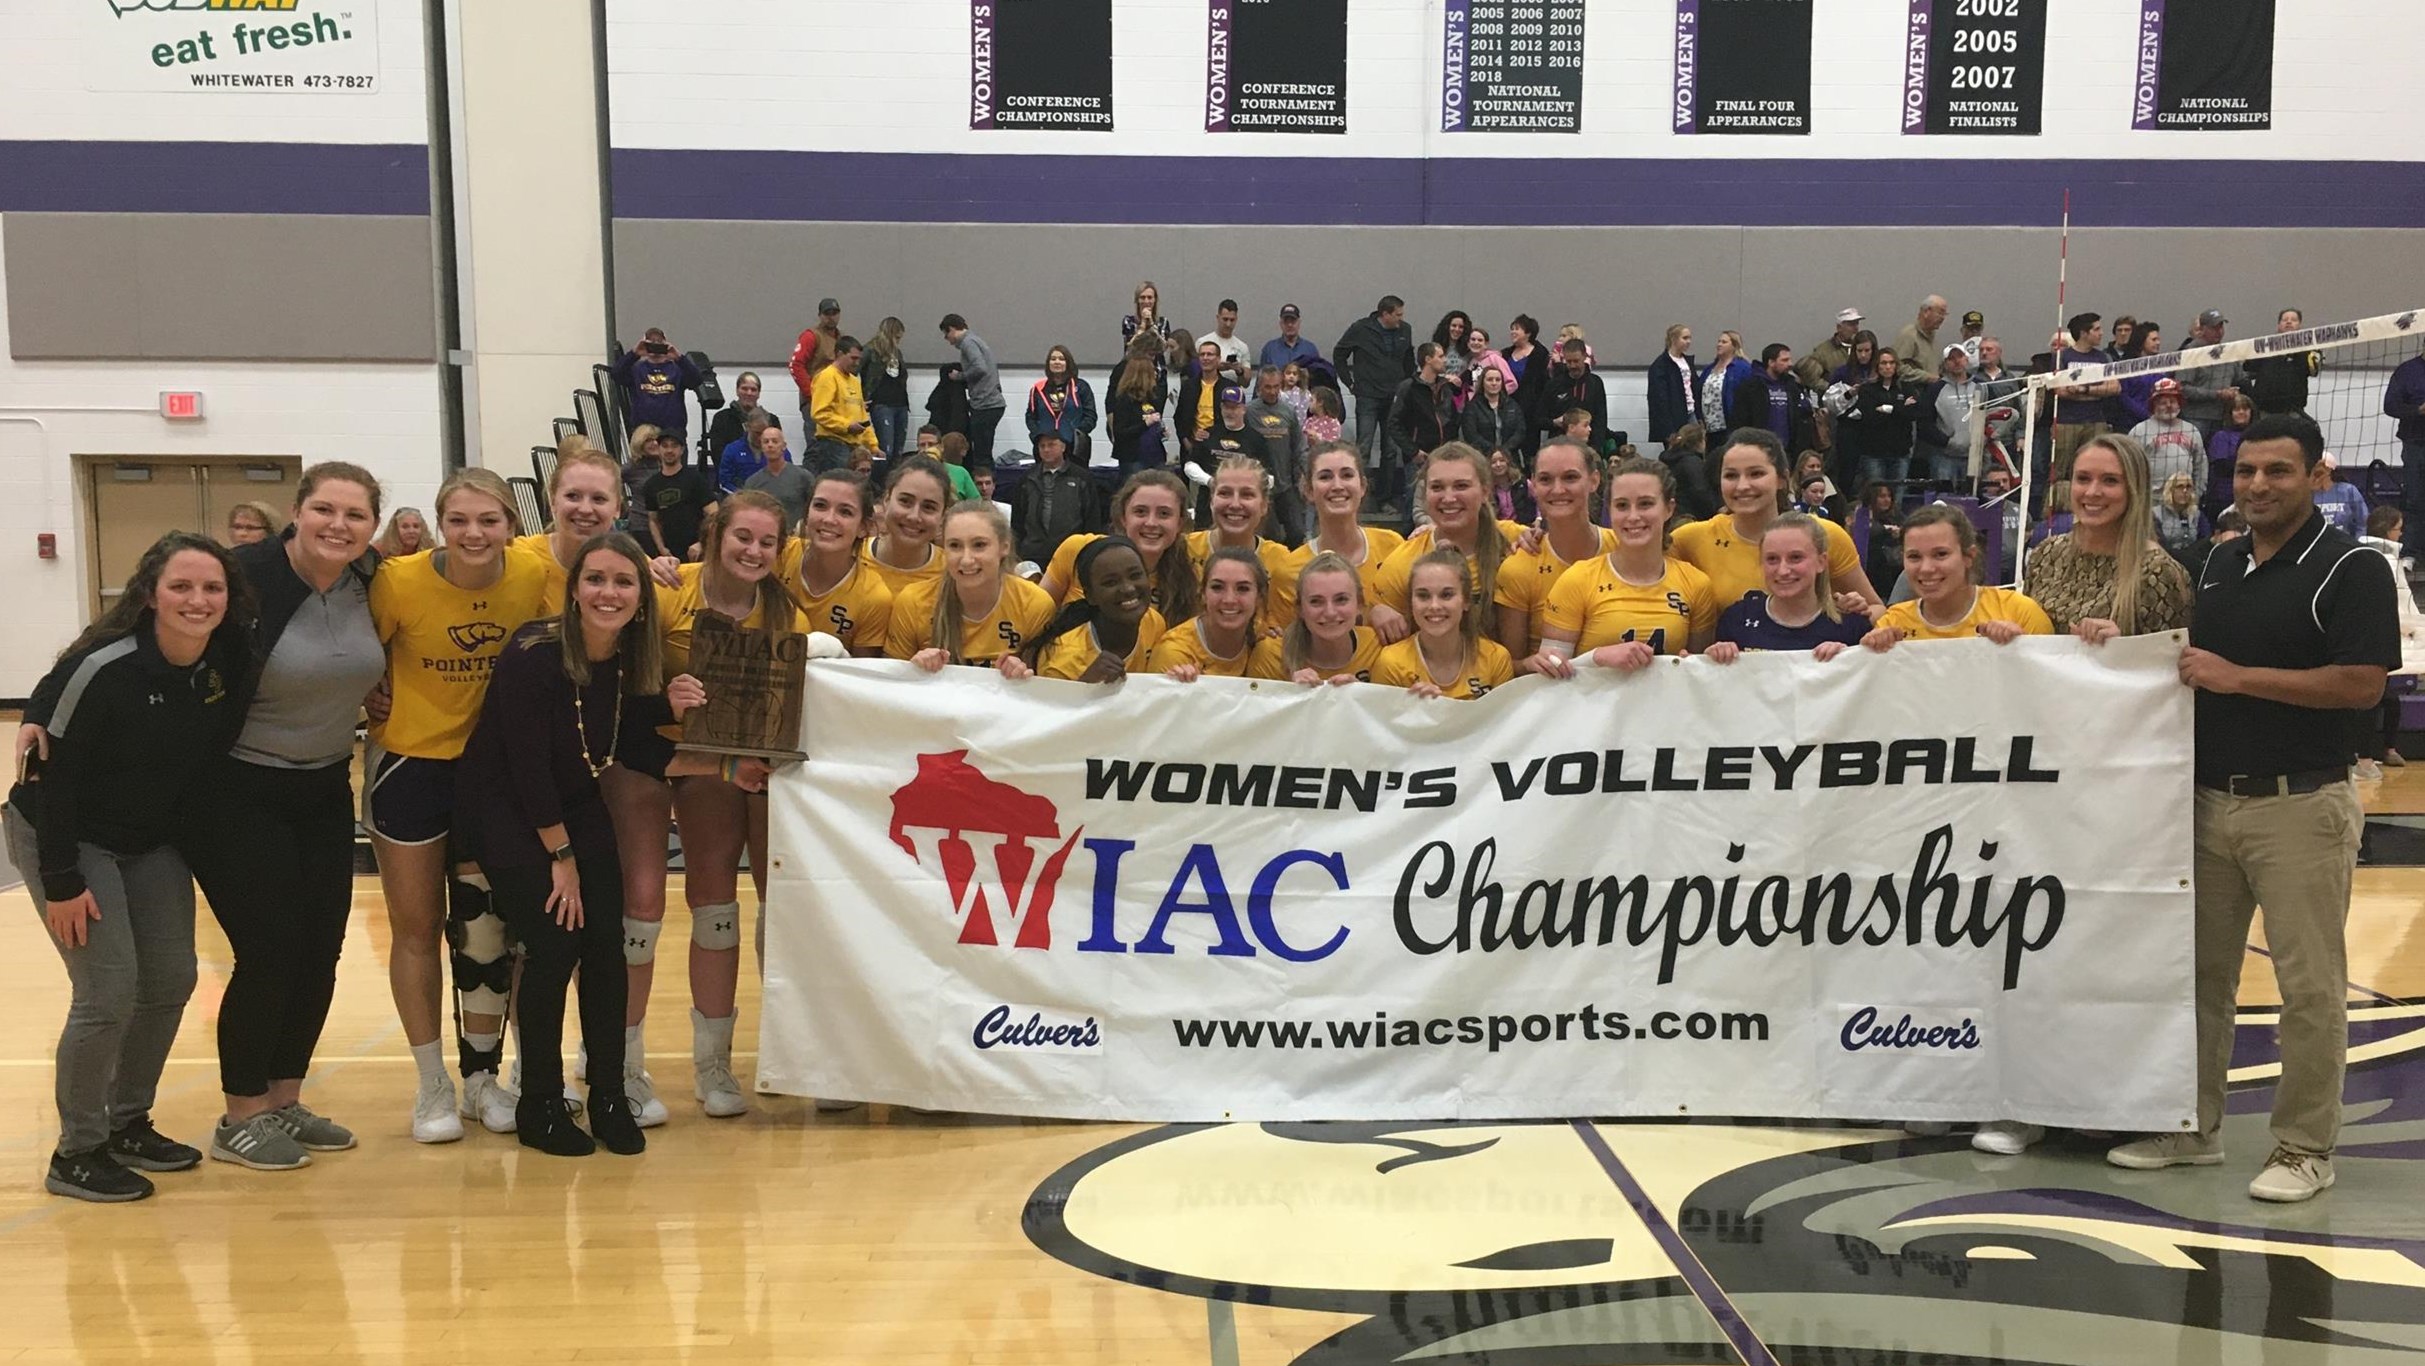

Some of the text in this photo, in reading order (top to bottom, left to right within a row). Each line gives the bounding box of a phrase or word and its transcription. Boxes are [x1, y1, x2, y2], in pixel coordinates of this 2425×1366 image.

[1471, 7, 1582, 20] 2005 2006 2007
[1471, 23, 1582, 36] 2008 2009 2010
[151, 30, 217, 68] eat
[232, 12, 352, 55] fresh.
[1470, 39, 1582, 52] 2011 2012 2013
[1953, 30, 2018, 53] 2005
[974, 4, 991, 123] WOMEN'S
[1209, 8, 1228, 125] WOMEN'S
[1470, 55, 1581, 67] 2014 2015 2016
[2136, 9, 2160, 123] WOMEN'S
[1445, 10, 1464, 129] WOMEN'S
[1470, 71, 1502, 82] 2018
[1676, 12, 1694, 127] WOMEN'S
[1905, 12, 1928, 128] WOMEN'S
[190, 74, 374, 89] WHITEWATER 473-7827
[1951, 66, 2016, 89] 2007
[1242, 83, 1335, 96] CONFERENCE
[1487, 85, 1561, 97] NATIONAL
[1006, 95, 1101, 109] CONFERENCE
[1240, 98, 1336, 111] TOURNAMENT
[1473, 100, 1575, 112] TOURNAMENT
[1716, 101, 1795, 112] FINAL FOUR
[1949, 101, 2019, 113] NATIONAL
[2180, 97, 2248, 109] NATIONAL
[996, 111, 1112, 125] CHAMPIONSHIPS
[1231, 113, 1345, 127] CHAMPIONSHIPS
[1471, 115, 1575, 127] APPEARANCES
[1706, 116, 1803, 128] APPEARANCES
[1949, 116, 2017, 128] FINALISTS
[2157, 112, 2270, 124] CHAMPIONSHIPS
[169, 395, 194, 415] EXIT
[1085, 735, 2060, 812] WOMEN'S VOLLEYBALL
[1393, 823, 2066, 991] Championship
[972, 1003, 1981, 1053] Culver's www.wiacsports.com Culver's
